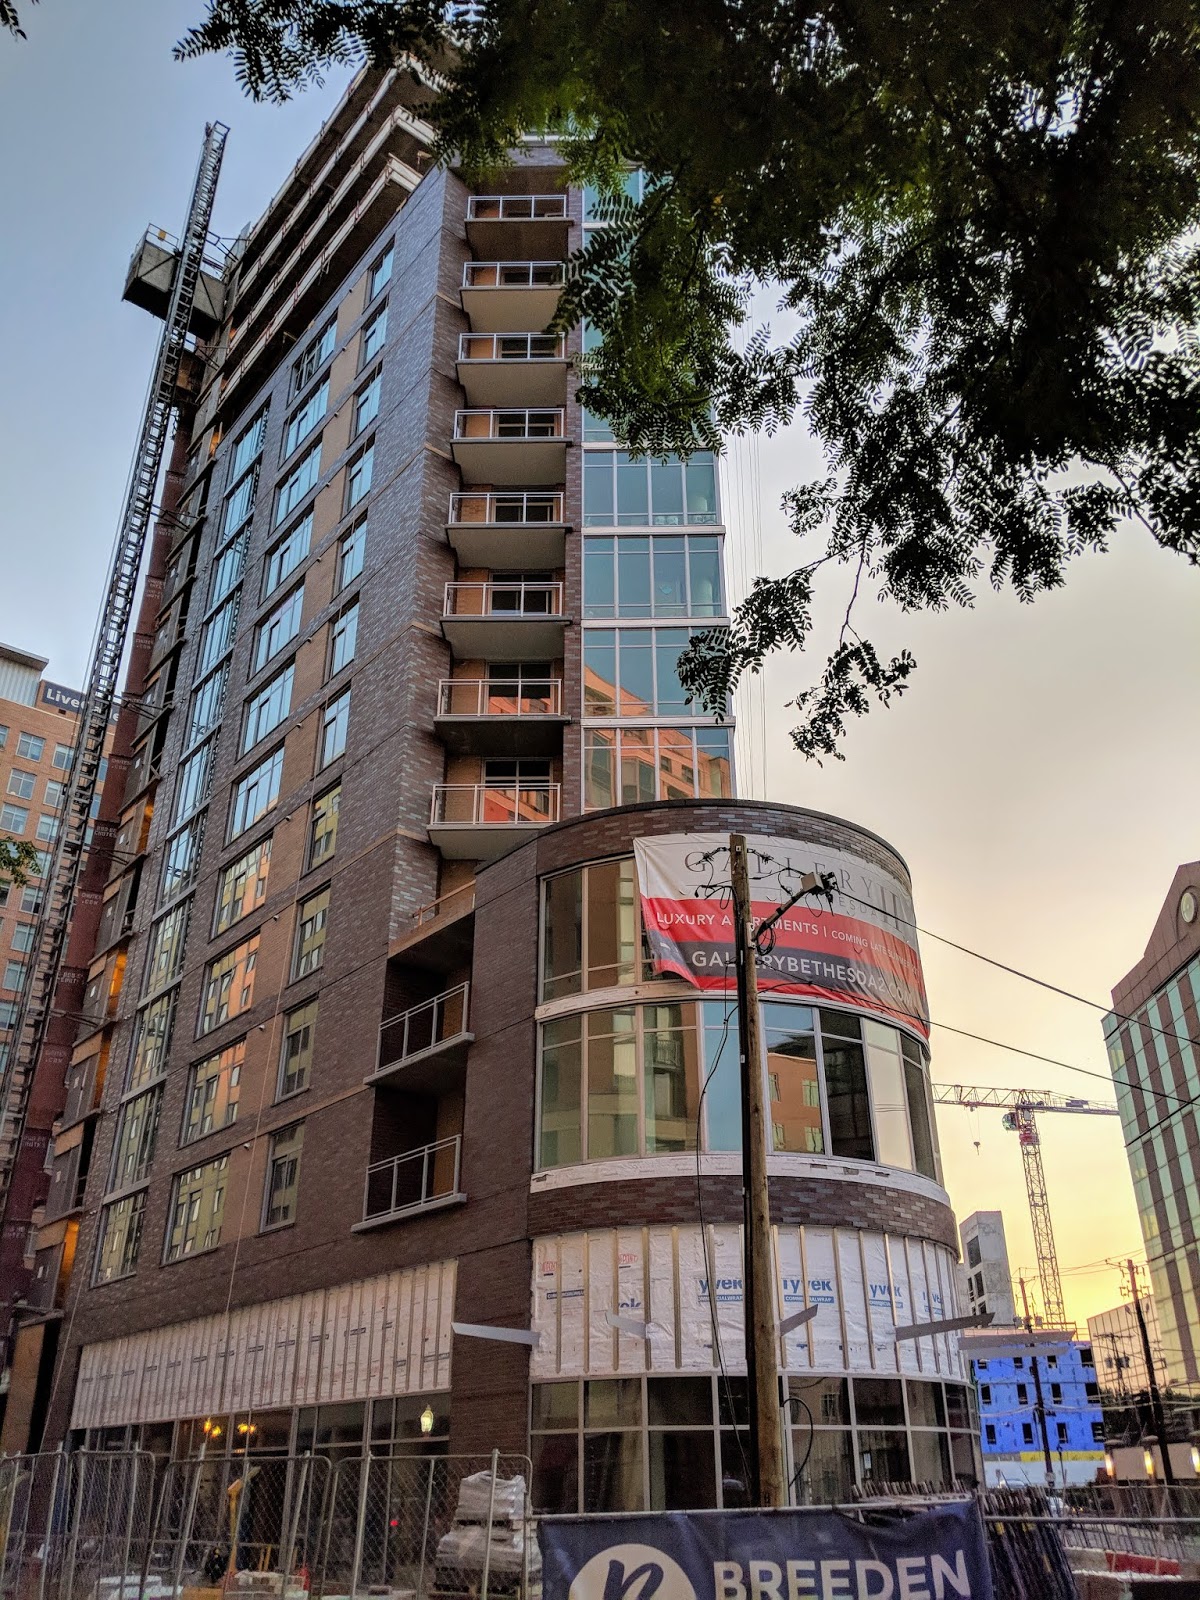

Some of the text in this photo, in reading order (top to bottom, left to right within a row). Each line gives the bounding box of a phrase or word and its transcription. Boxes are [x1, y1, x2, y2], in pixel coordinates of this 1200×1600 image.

[656, 911, 715, 926] LUXURY
[831, 930, 869, 948] COMING
[870, 941, 888, 955] LATE
[713, 1549, 972, 1600] BREEDEN
